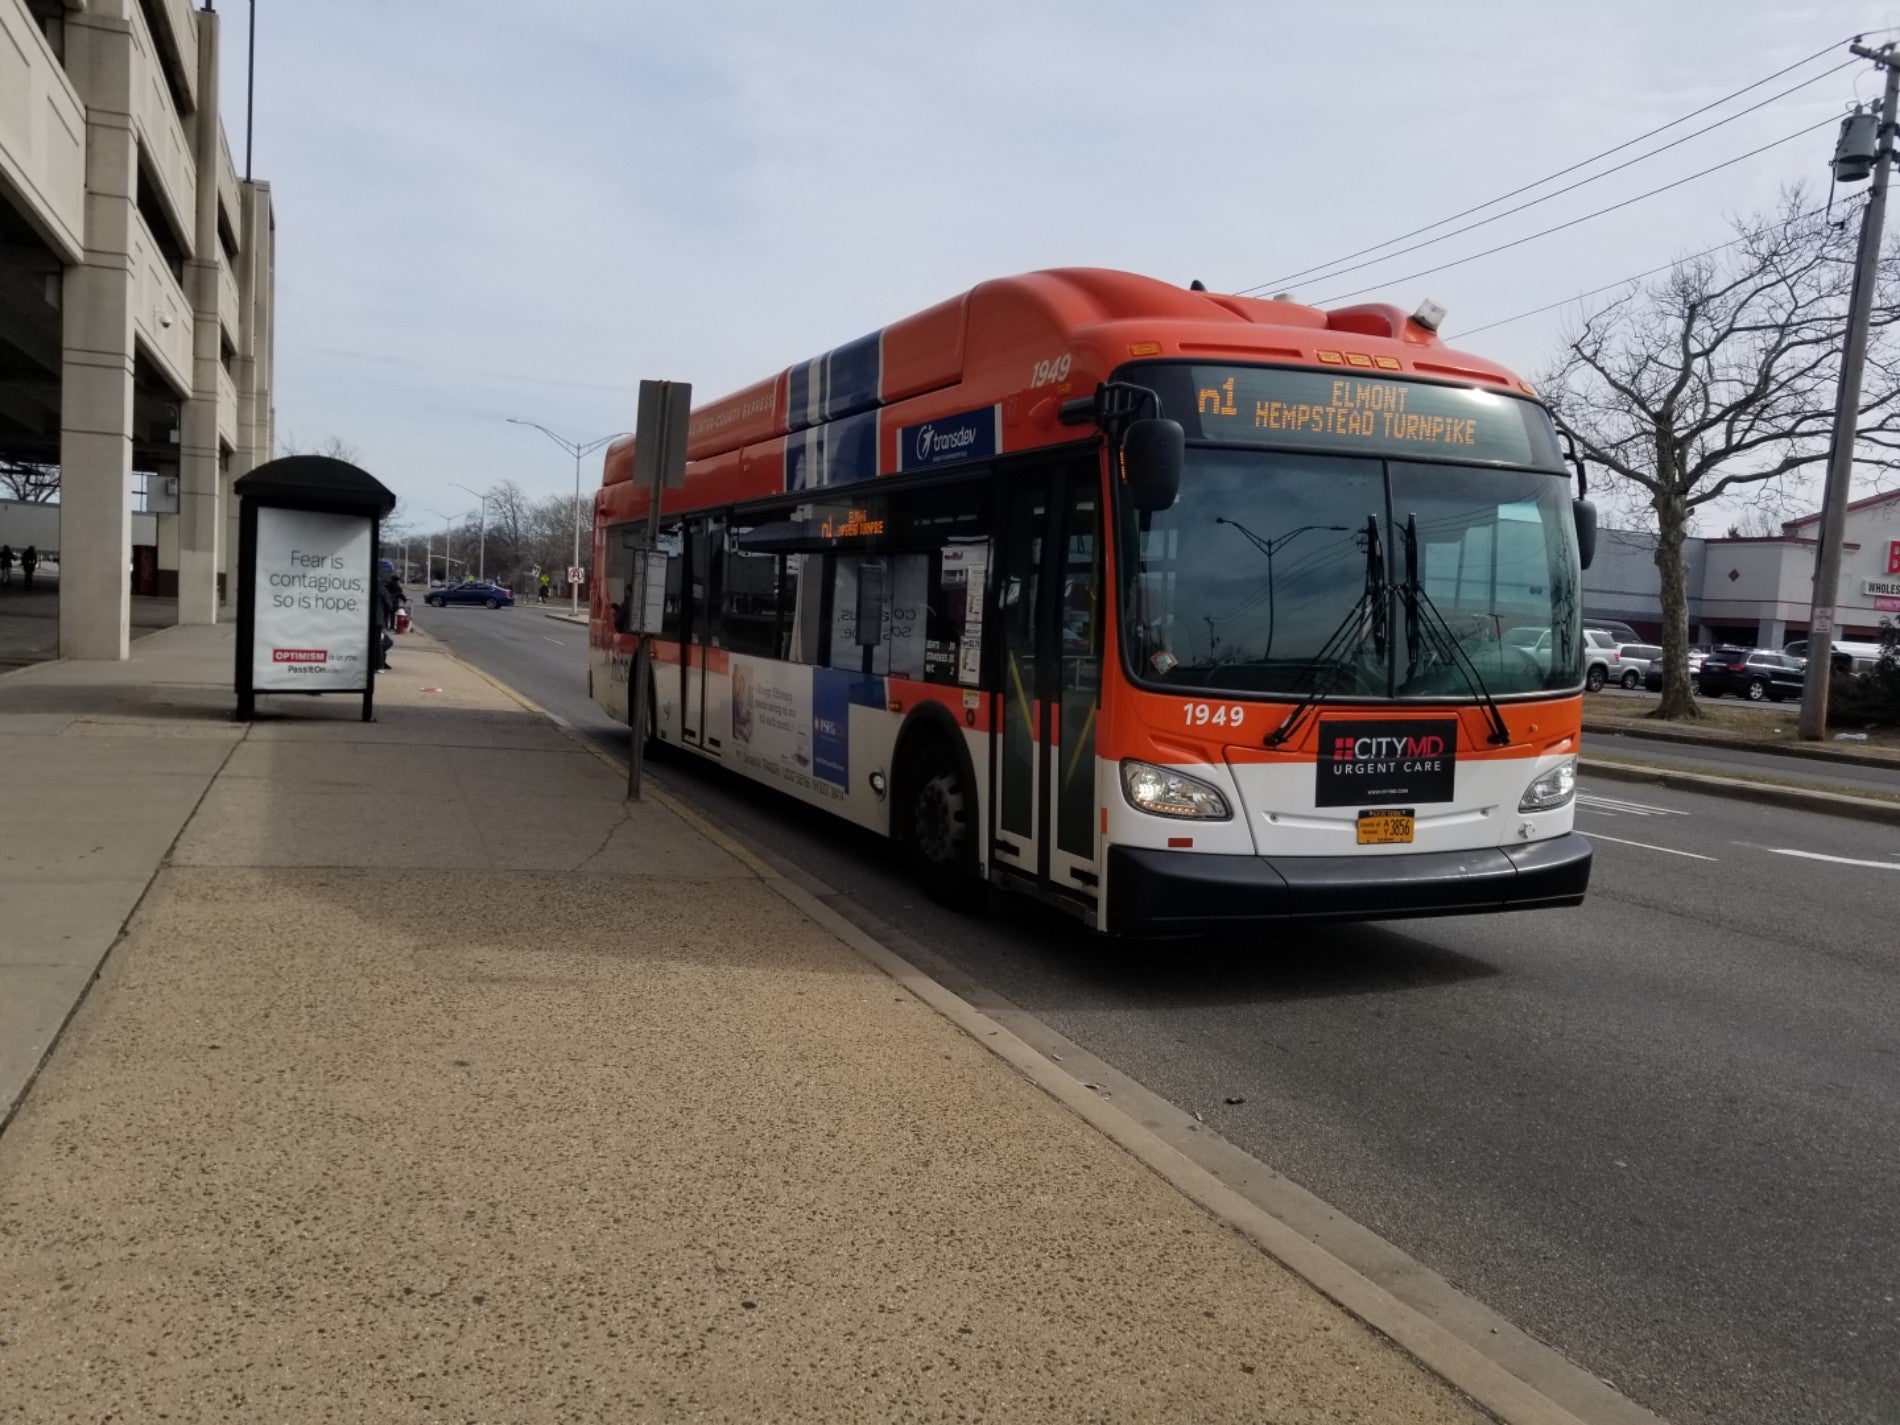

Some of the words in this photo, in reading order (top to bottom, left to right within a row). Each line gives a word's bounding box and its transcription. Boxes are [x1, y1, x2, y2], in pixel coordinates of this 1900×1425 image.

[1030, 354, 1072, 388] 1949
[1198, 377, 1237, 416] n1
[1332, 381, 1409, 412] ELMONT
[1255, 401, 1374, 436] HEMPSTEAD
[1384, 412, 1477, 445] TURNPIKE
[933, 426, 976, 451] transdev
[290, 550, 327, 568] Fear
[330, 552, 344, 570] is
[269, 572, 364, 593] contagious,
[273, 595, 294, 608] so
[297, 594, 310, 609] is
[314, 594, 359, 612] hope.
[275, 652, 325, 661] OPTIMISM
[1183, 703, 1244, 727] 1949
[1354, 736, 1445, 760] CITYMD
[1333, 763, 1397, 775] URGENT
[1403, 761, 1442, 772] CARE
